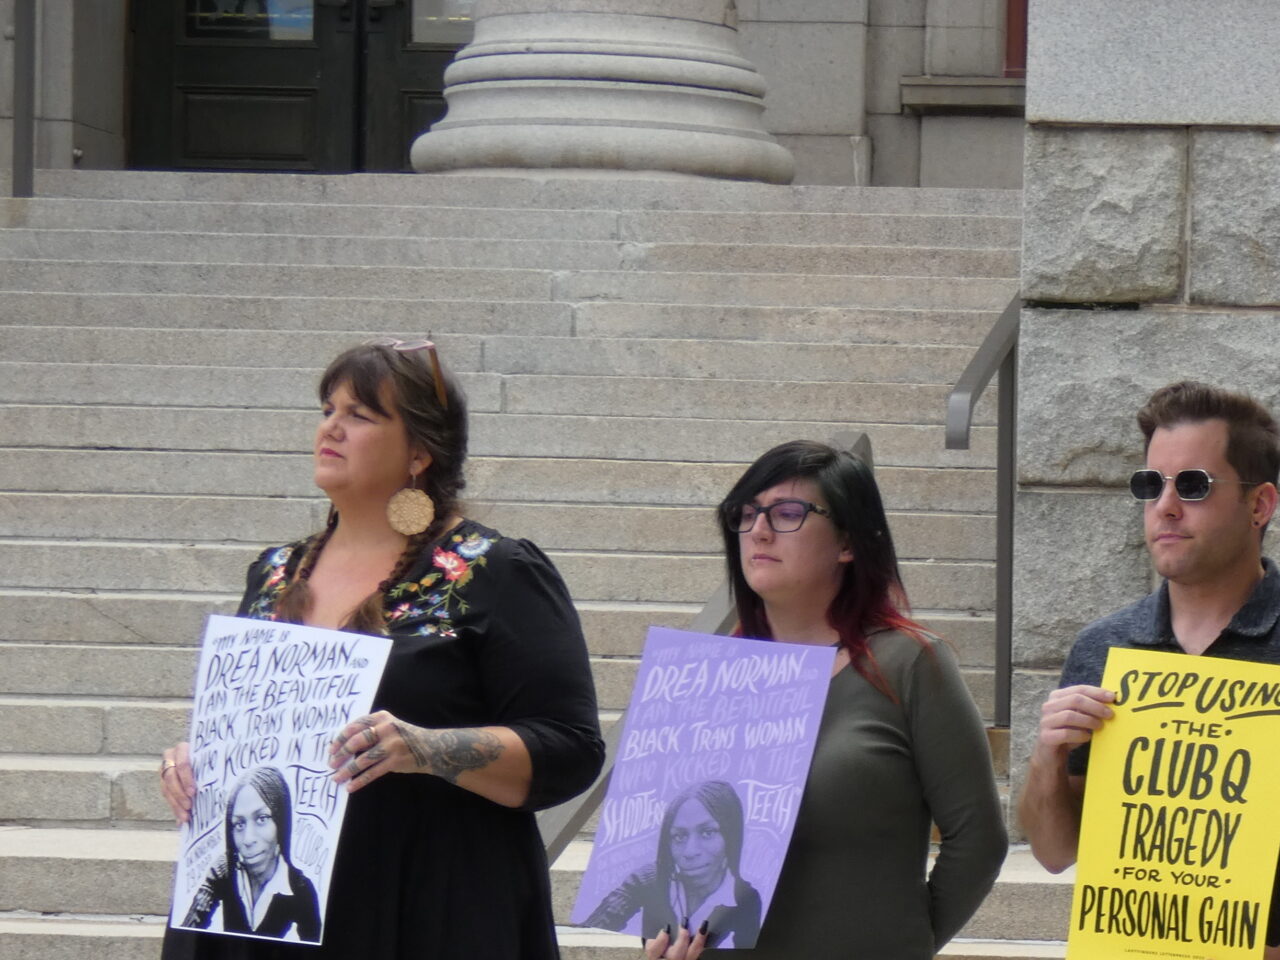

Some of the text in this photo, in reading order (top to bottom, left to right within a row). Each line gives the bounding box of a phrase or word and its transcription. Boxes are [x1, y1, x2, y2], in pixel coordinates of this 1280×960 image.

[241, 628, 276, 645] NAME
[205, 646, 260, 691] DREA
[263, 639, 360, 680] NORMAN
[640, 659, 708, 703] DREA
[709, 649, 808, 696] NORMAN
[1114, 669, 1199, 707] STOP
[204, 690, 227, 716] AM
[234, 684, 262, 708] THE
[262, 673, 361, 711] BEAUTIFUL
[710, 685, 814, 726] BEAUTIFUL
[194, 700, 356, 753] BLACK TRANS WOMAN
[622, 714, 809, 761] BLACK TRANS WOMAN
[223, 736, 280, 786] KICKED
[286, 734, 304, 761] IN
[661, 750, 731, 799] KICKED
[738, 750, 759, 777] IN
[767, 741, 808, 782] THE
[1122, 736, 1252, 804] CLUB Q
[1119, 801, 1242, 870] TRAGEDY
[1122, 866, 1222, 889] FOR YOUR
[1078, 884, 1261, 950] PERSONAL GAIN
